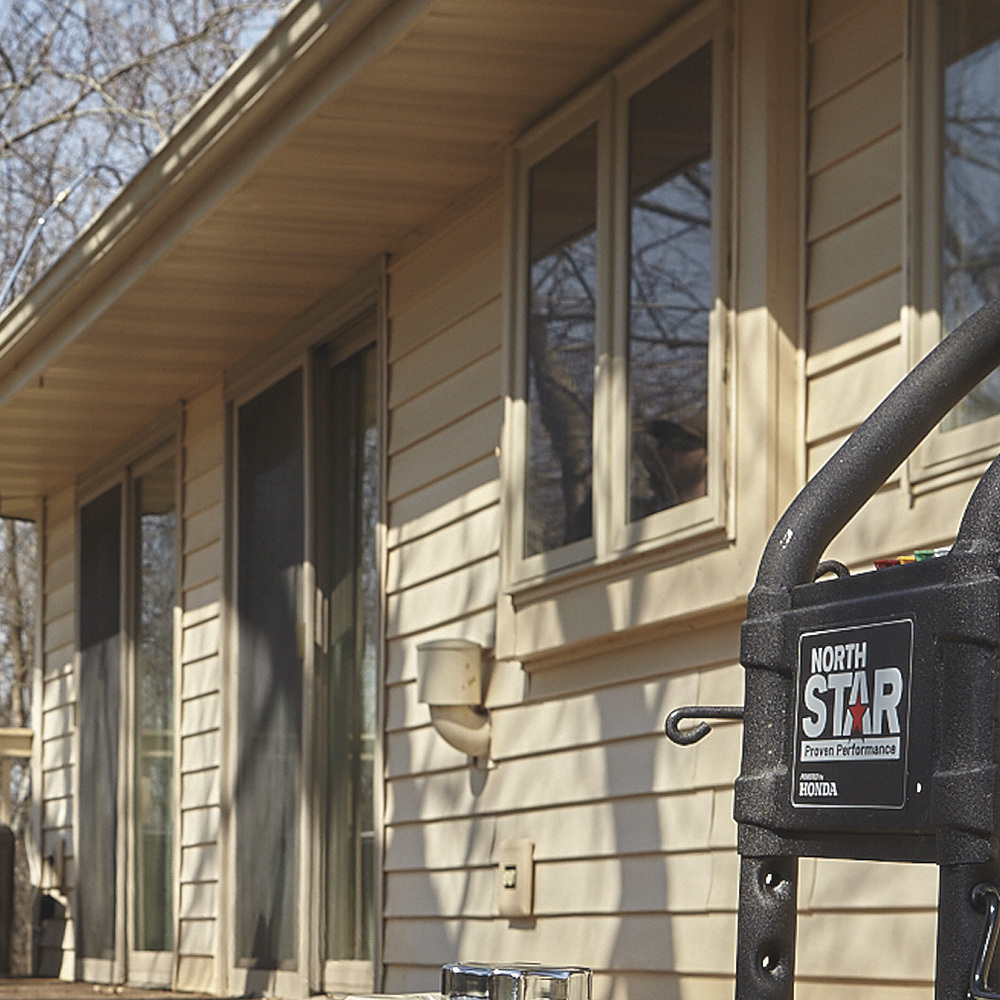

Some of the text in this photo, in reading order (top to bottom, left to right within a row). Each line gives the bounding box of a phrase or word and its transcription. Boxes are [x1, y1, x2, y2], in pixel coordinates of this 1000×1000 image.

[811, 642, 867, 674] NORTH
[802, 668, 903, 738] STAR
[804, 742, 896, 757] Proven Performance
[799, 782, 838, 796] HONDA
